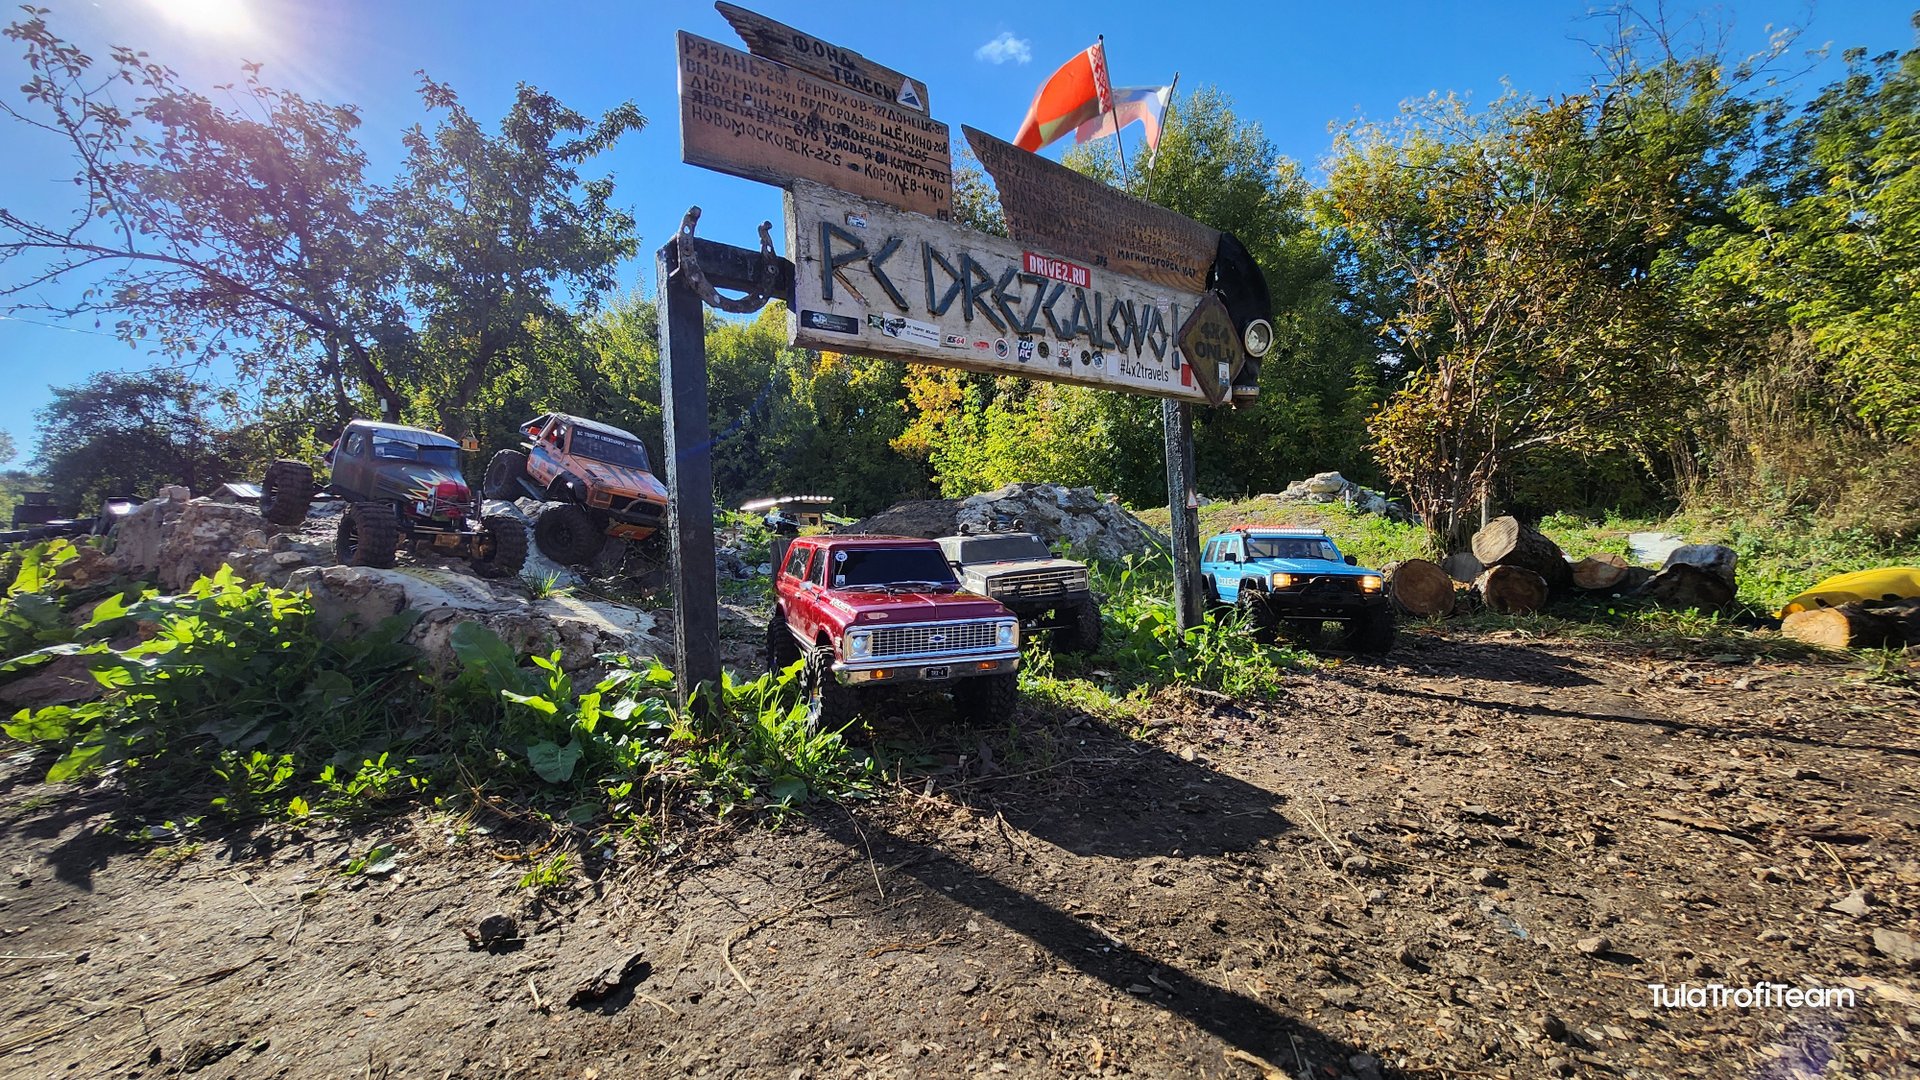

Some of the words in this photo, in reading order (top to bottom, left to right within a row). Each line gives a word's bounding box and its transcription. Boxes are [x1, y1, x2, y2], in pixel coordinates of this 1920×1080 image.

[818, 221, 910, 311] RC
[1029, 255, 1086, 286] DRIVE2.RU
[1017, 340, 1035, 350] TOP
[1119, 359, 1169, 383] #4x2travels
